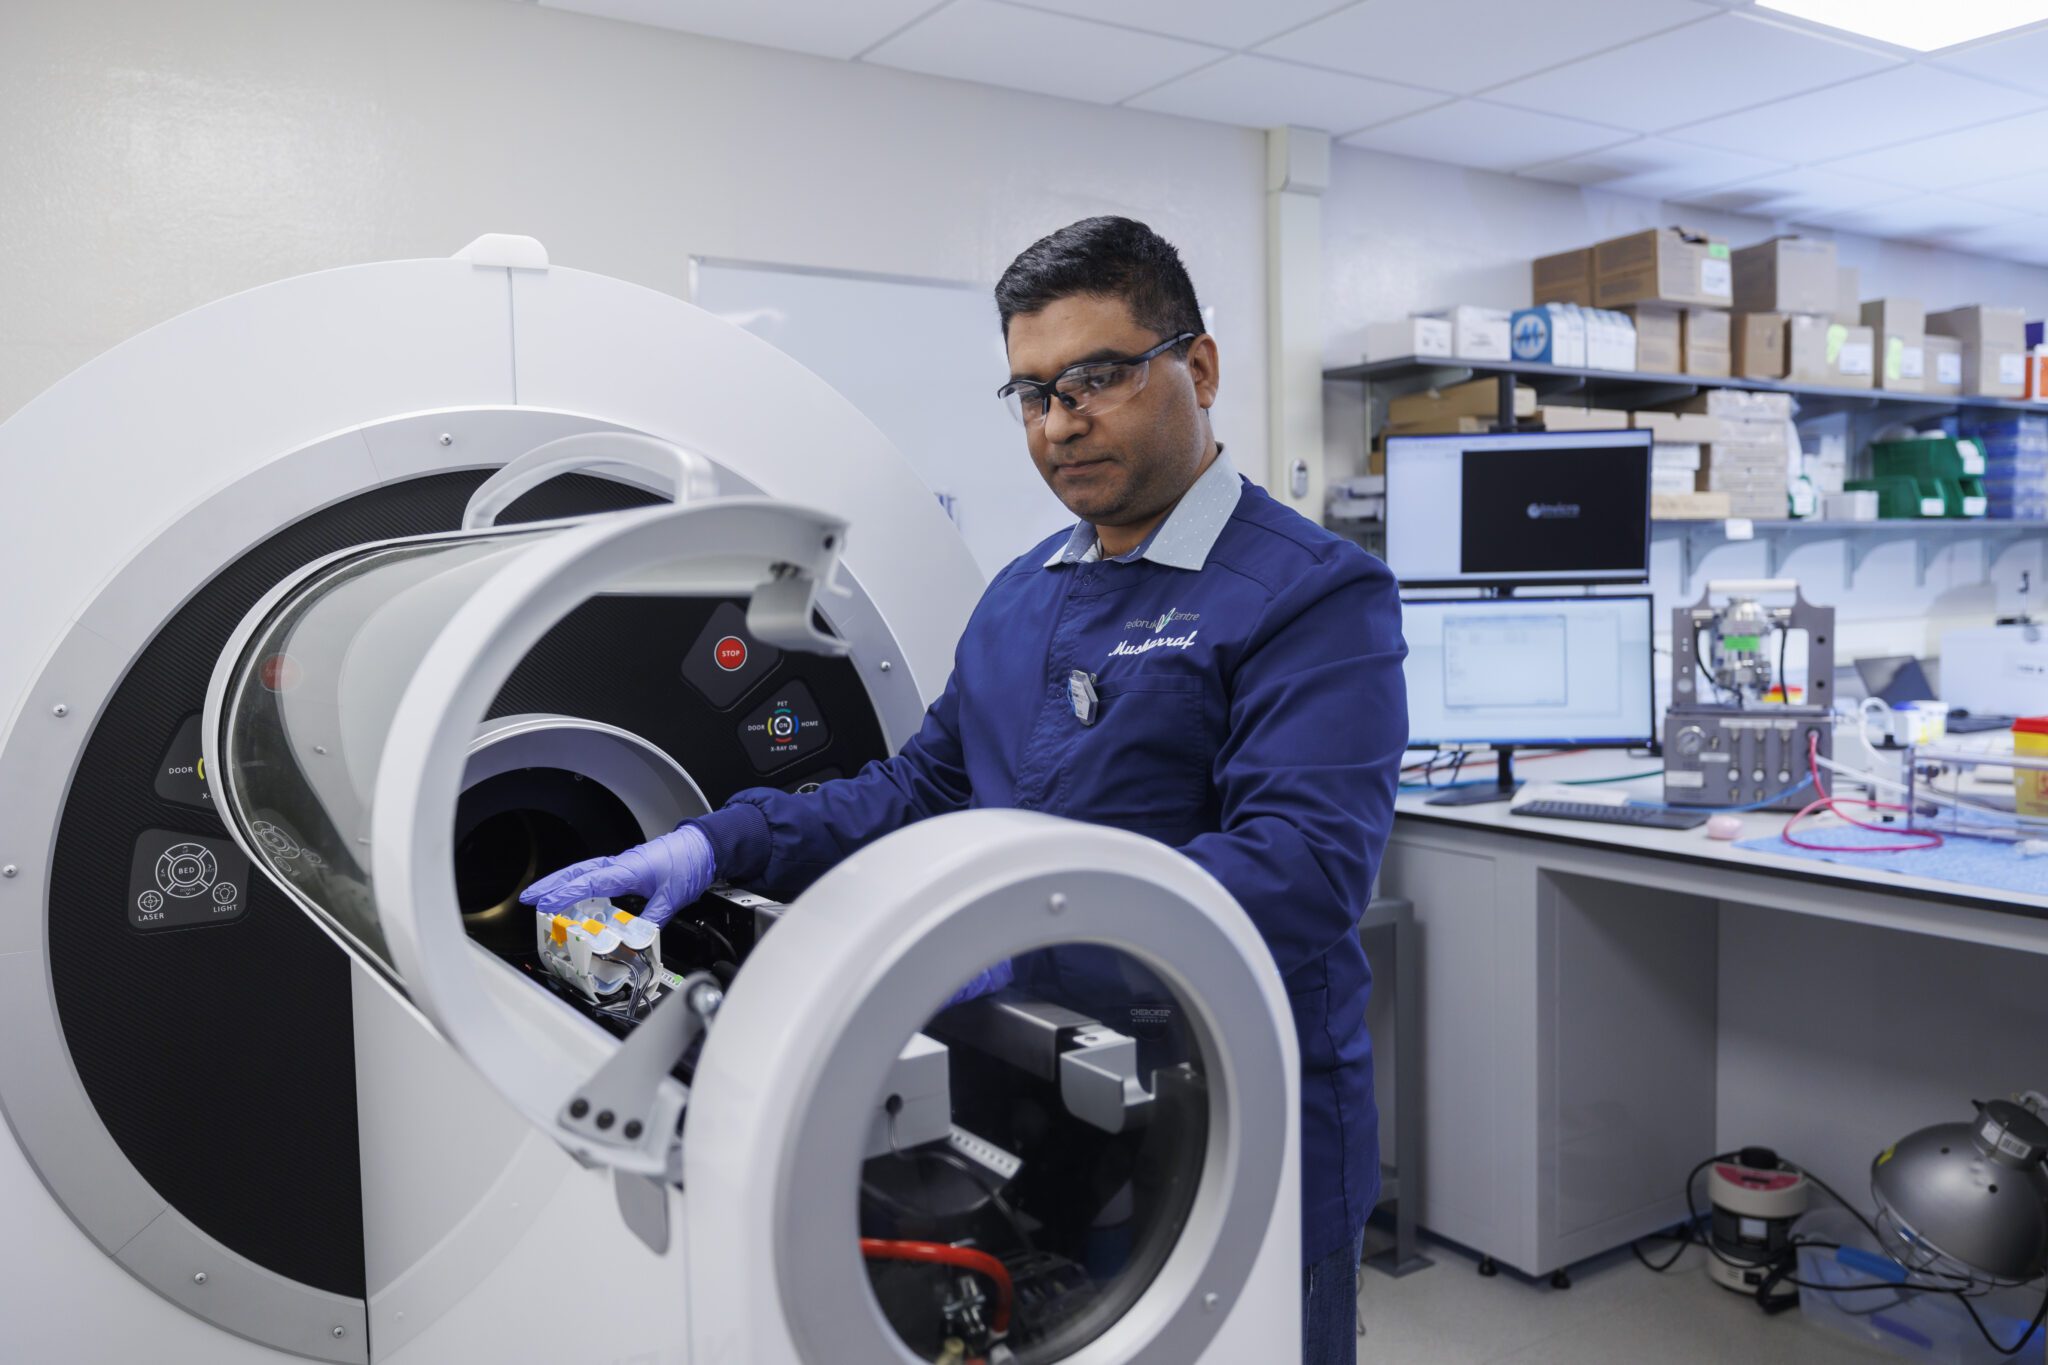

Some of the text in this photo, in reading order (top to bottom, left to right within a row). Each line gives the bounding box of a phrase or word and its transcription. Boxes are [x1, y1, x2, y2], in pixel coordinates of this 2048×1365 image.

[168, 767, 193, 775] DOOR
[178, 866, 195, 875] BED
[213, 904, 238, 913] LIGHT
[138, 913, 165, 922] LASER
